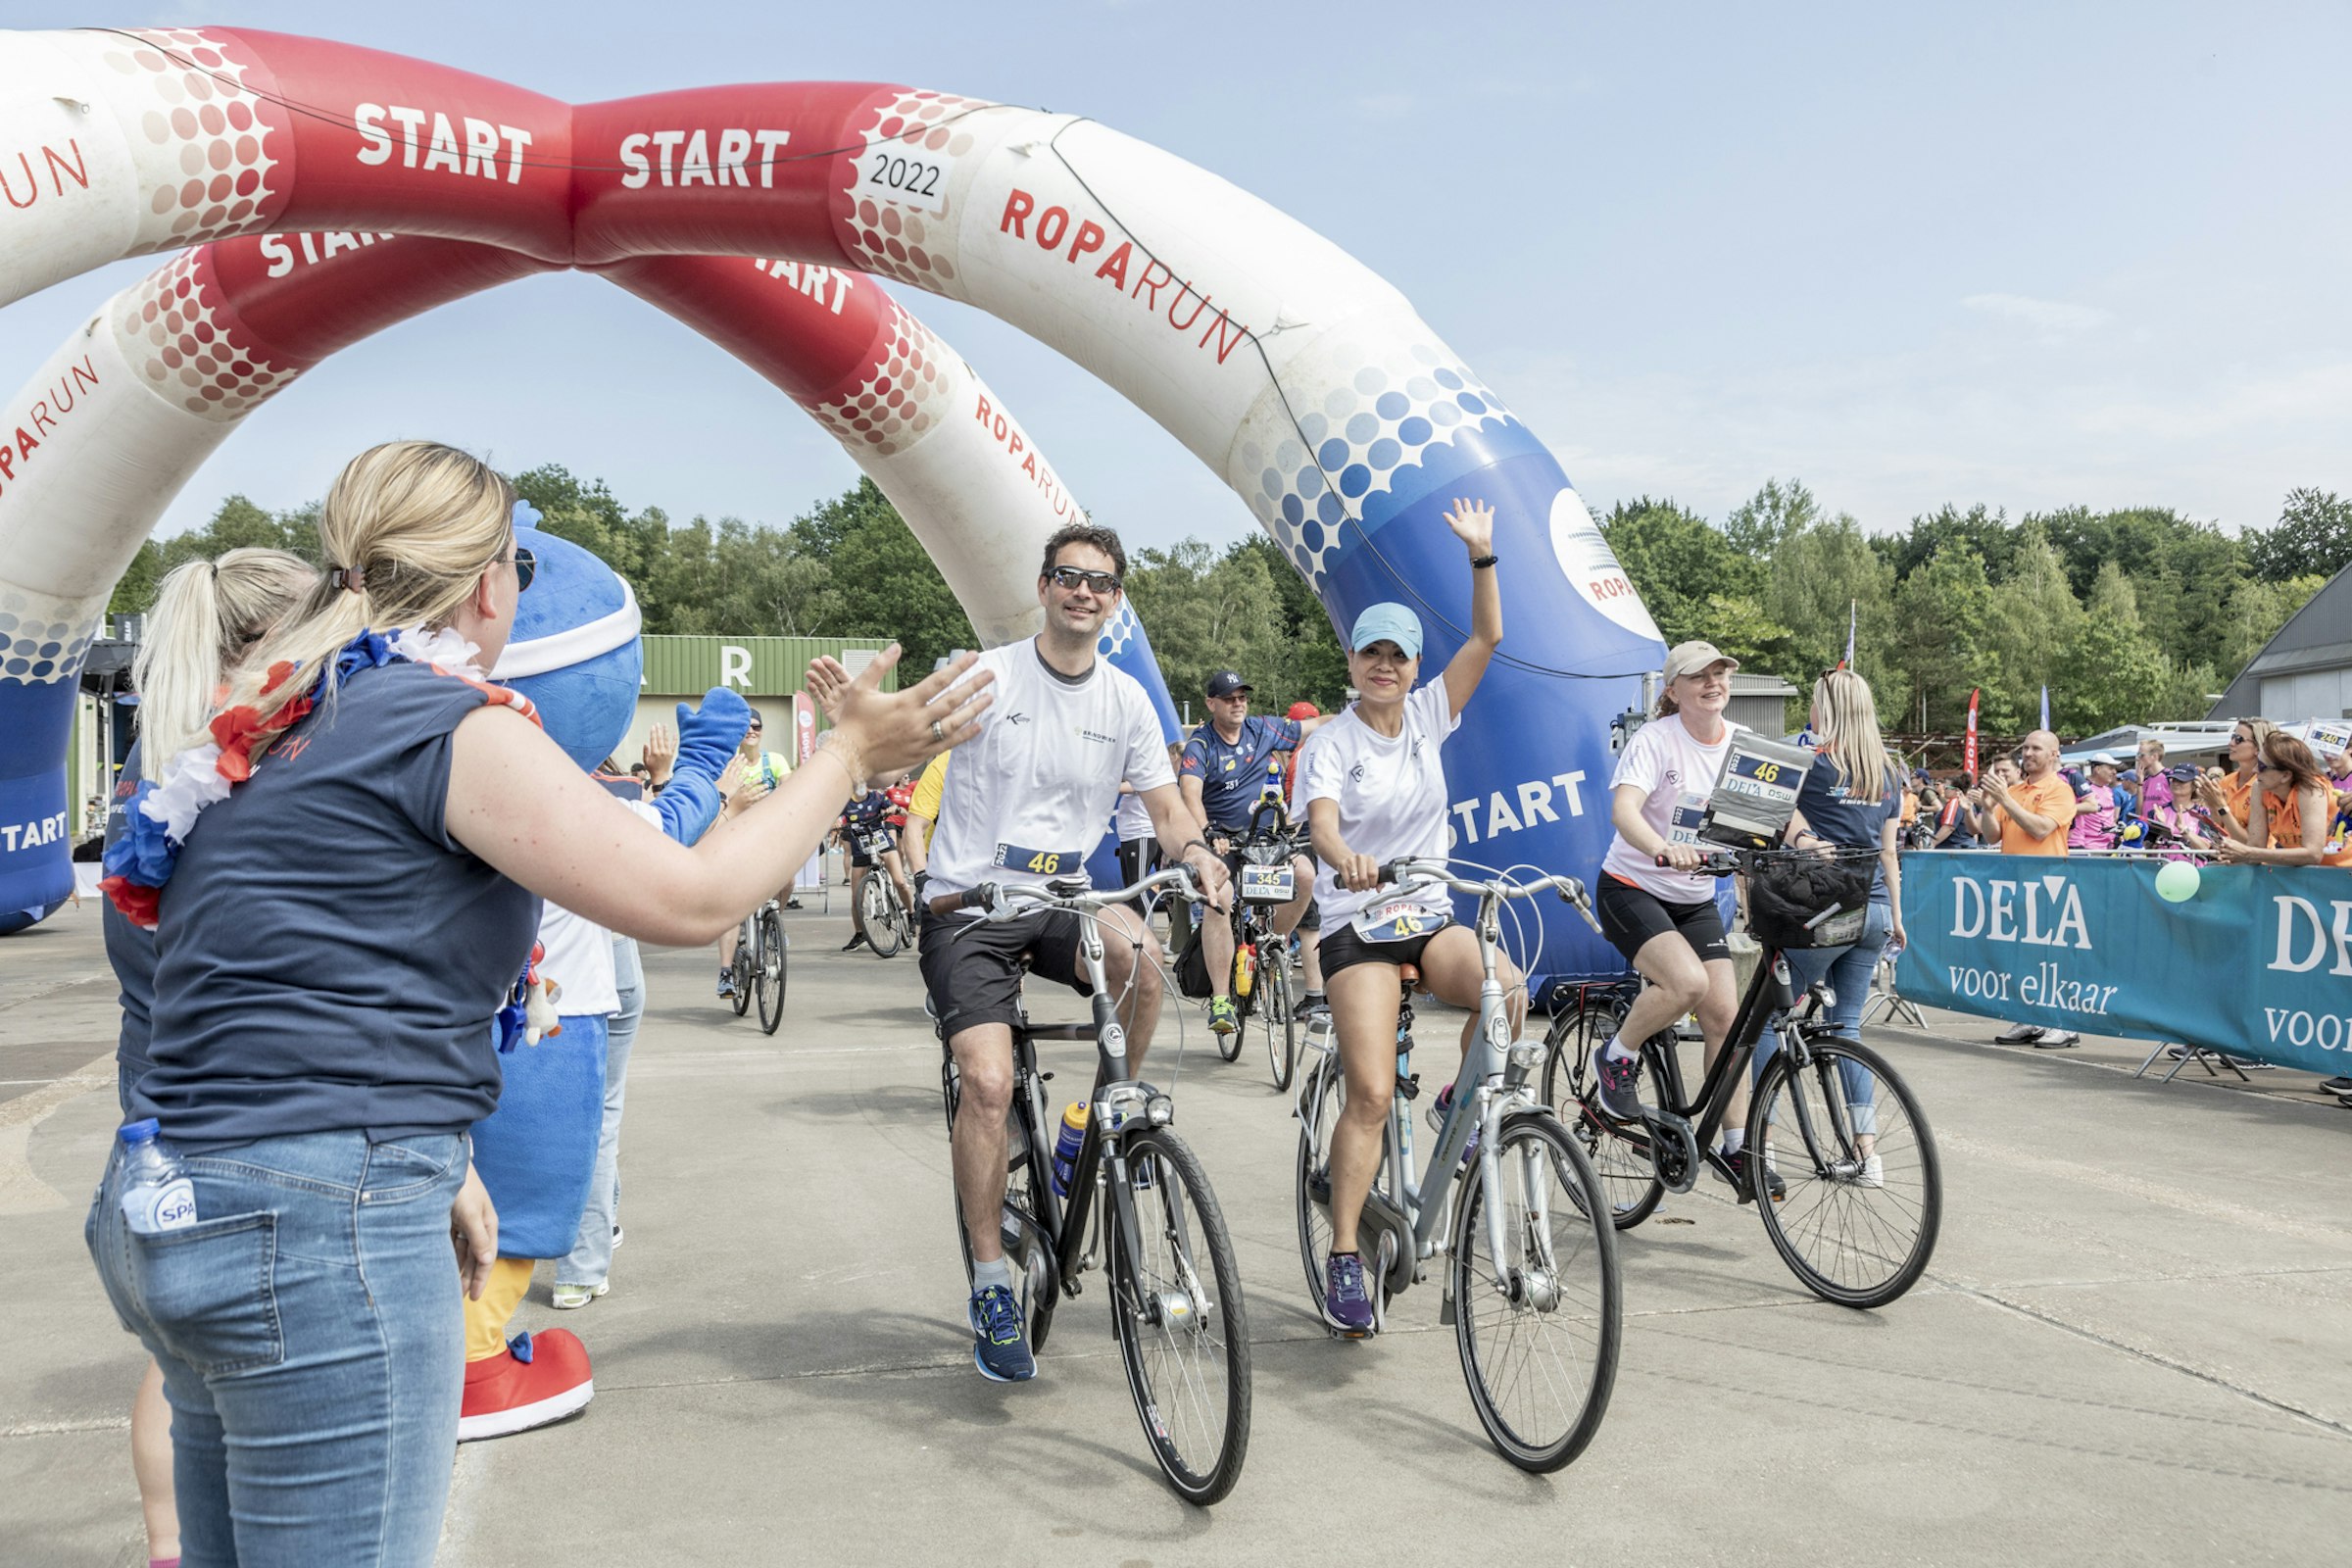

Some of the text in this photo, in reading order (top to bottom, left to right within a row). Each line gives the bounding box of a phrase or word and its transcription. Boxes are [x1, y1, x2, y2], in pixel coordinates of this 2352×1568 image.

[354, 103, 532, 185] START
[618, 128, 791, 189] START
[870, 154, 940, 198] 2022
[1000, 187, 1250, 366] ROPARUN
[1729, 753, 1740, 773] 2022
[1753, 762, 1781, 783] 46
[1, 810, 67, 853] TART
[996, 844, 1008, 866] 2022
[1028, 852, 1059, 874] 46
[1256, 873, 1281, 886] 345
[1395, 916, 1424, 937] 46
[1949, 875, 2093, 951] DELA
[1948, 961, 2119, 1016] voor elkaar
[162, 1202, 194, 1223] SPA
